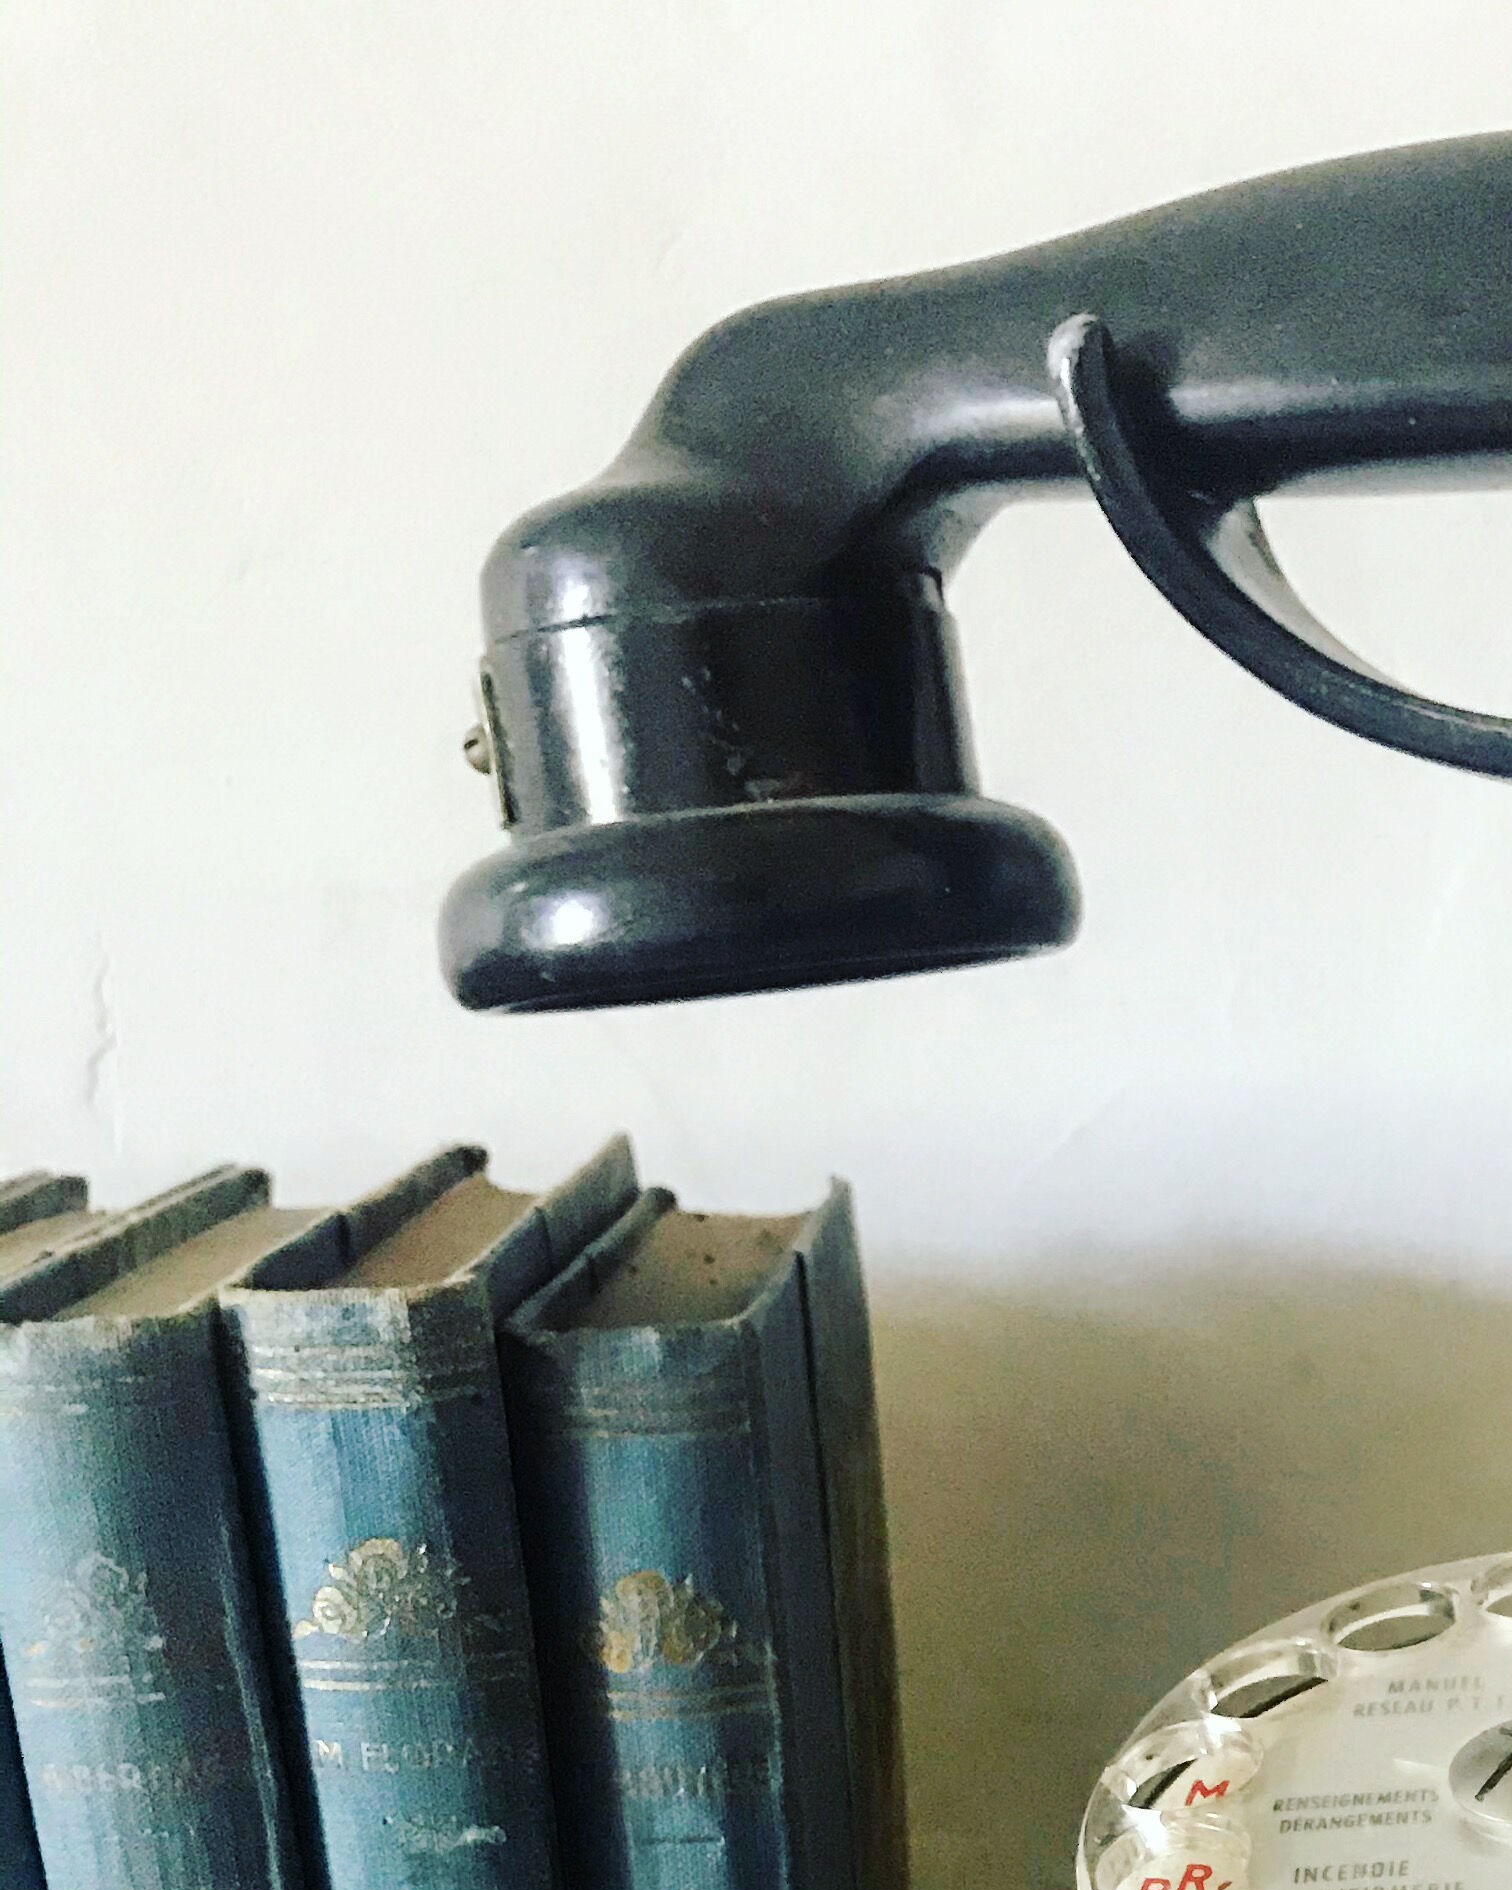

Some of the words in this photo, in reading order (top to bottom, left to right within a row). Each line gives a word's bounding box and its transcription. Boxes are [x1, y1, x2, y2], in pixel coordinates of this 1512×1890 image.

[1387, 1676, 1484, 1694] MANUEL
[1272, 1788, 1440, 1812] RENSEIGNEMENTS
[1293, 1860, 1410, 1885] INCENDIE
